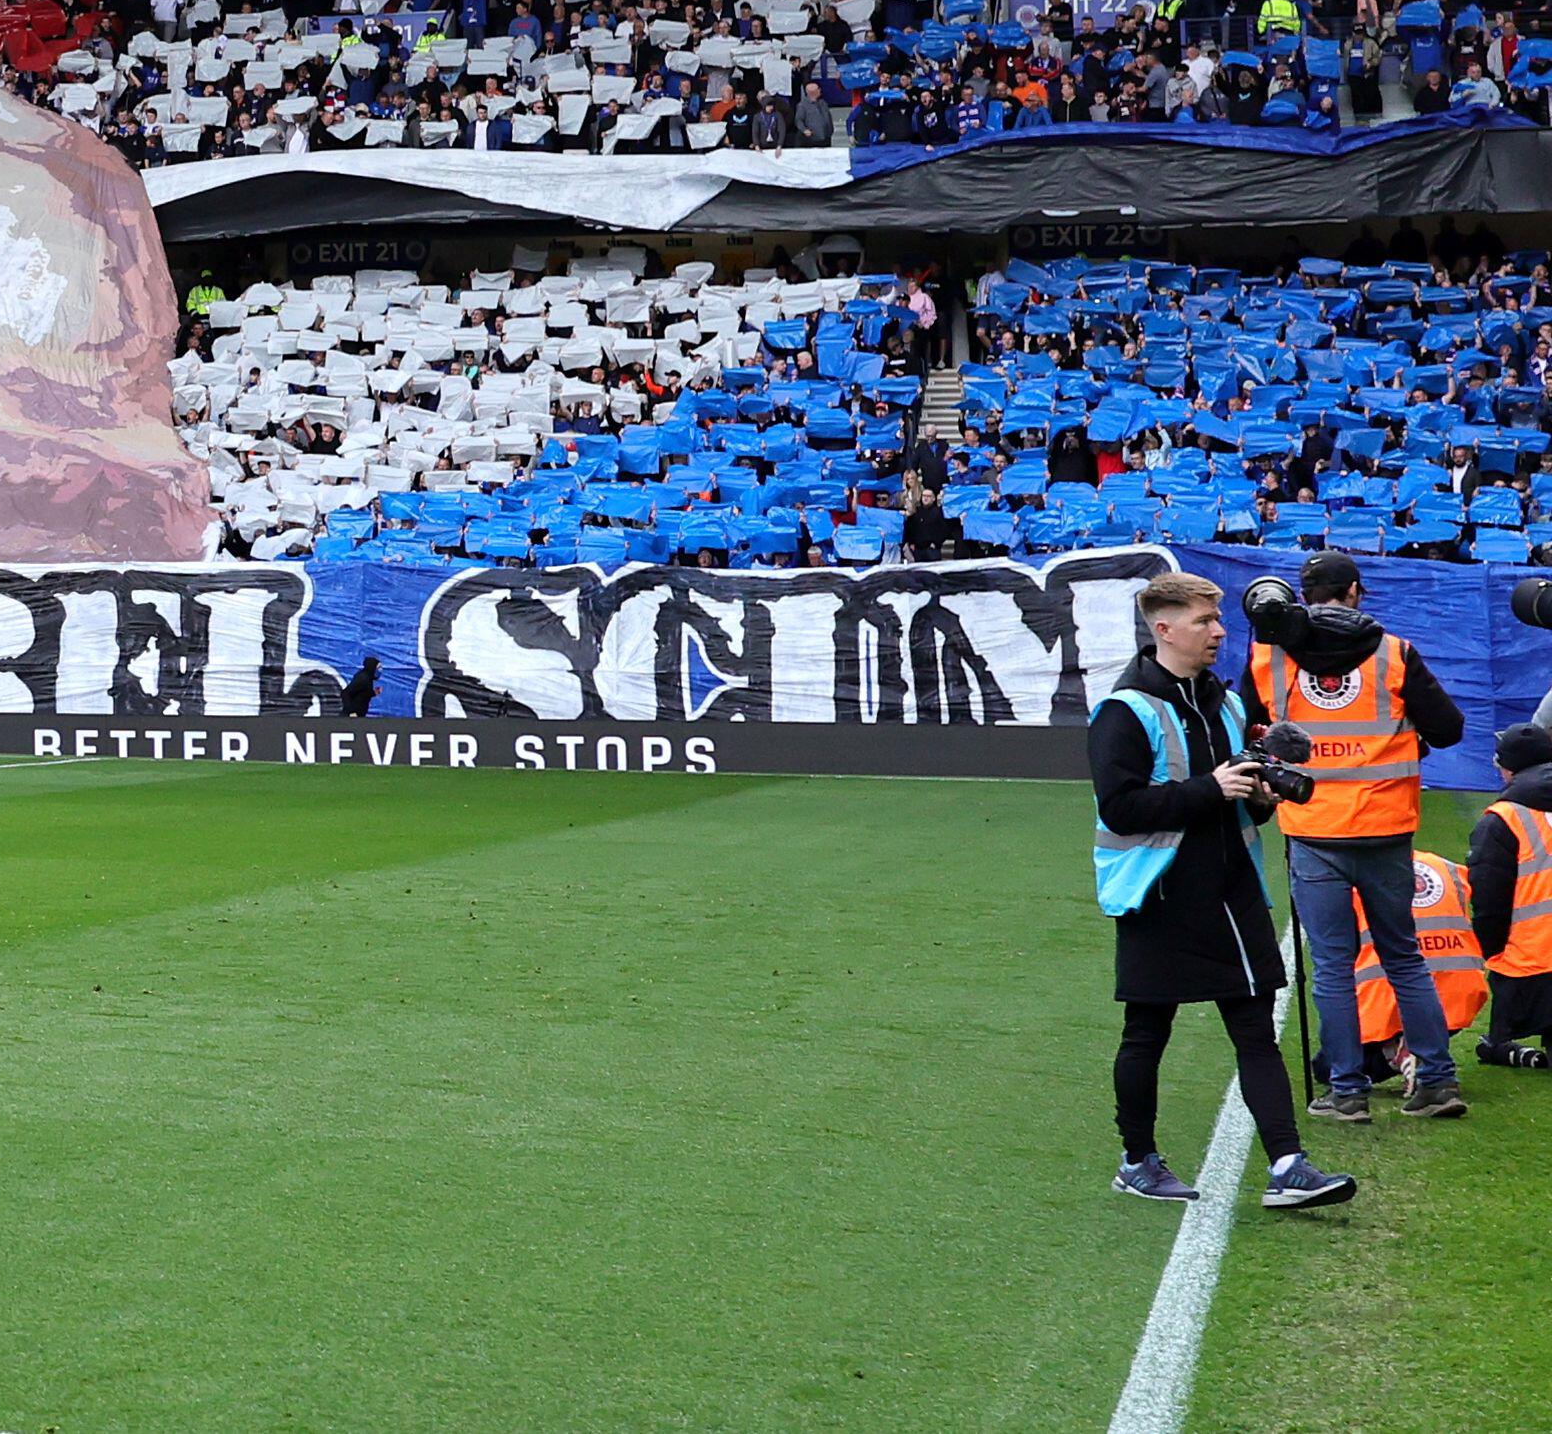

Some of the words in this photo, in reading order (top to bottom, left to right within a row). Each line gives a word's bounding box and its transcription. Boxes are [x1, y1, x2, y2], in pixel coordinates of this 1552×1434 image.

[1041, 225, 1097, 247] EXIT
[1105, 224, 1136, 246] 22
[319, 242, 369, 263] EXIT
[376, 242, 398, 262] 21
[33, 729, 249, 761] BETTER
[285, 732, 479, 768] NEVER
[514, 735, 716, 774] STOPS
